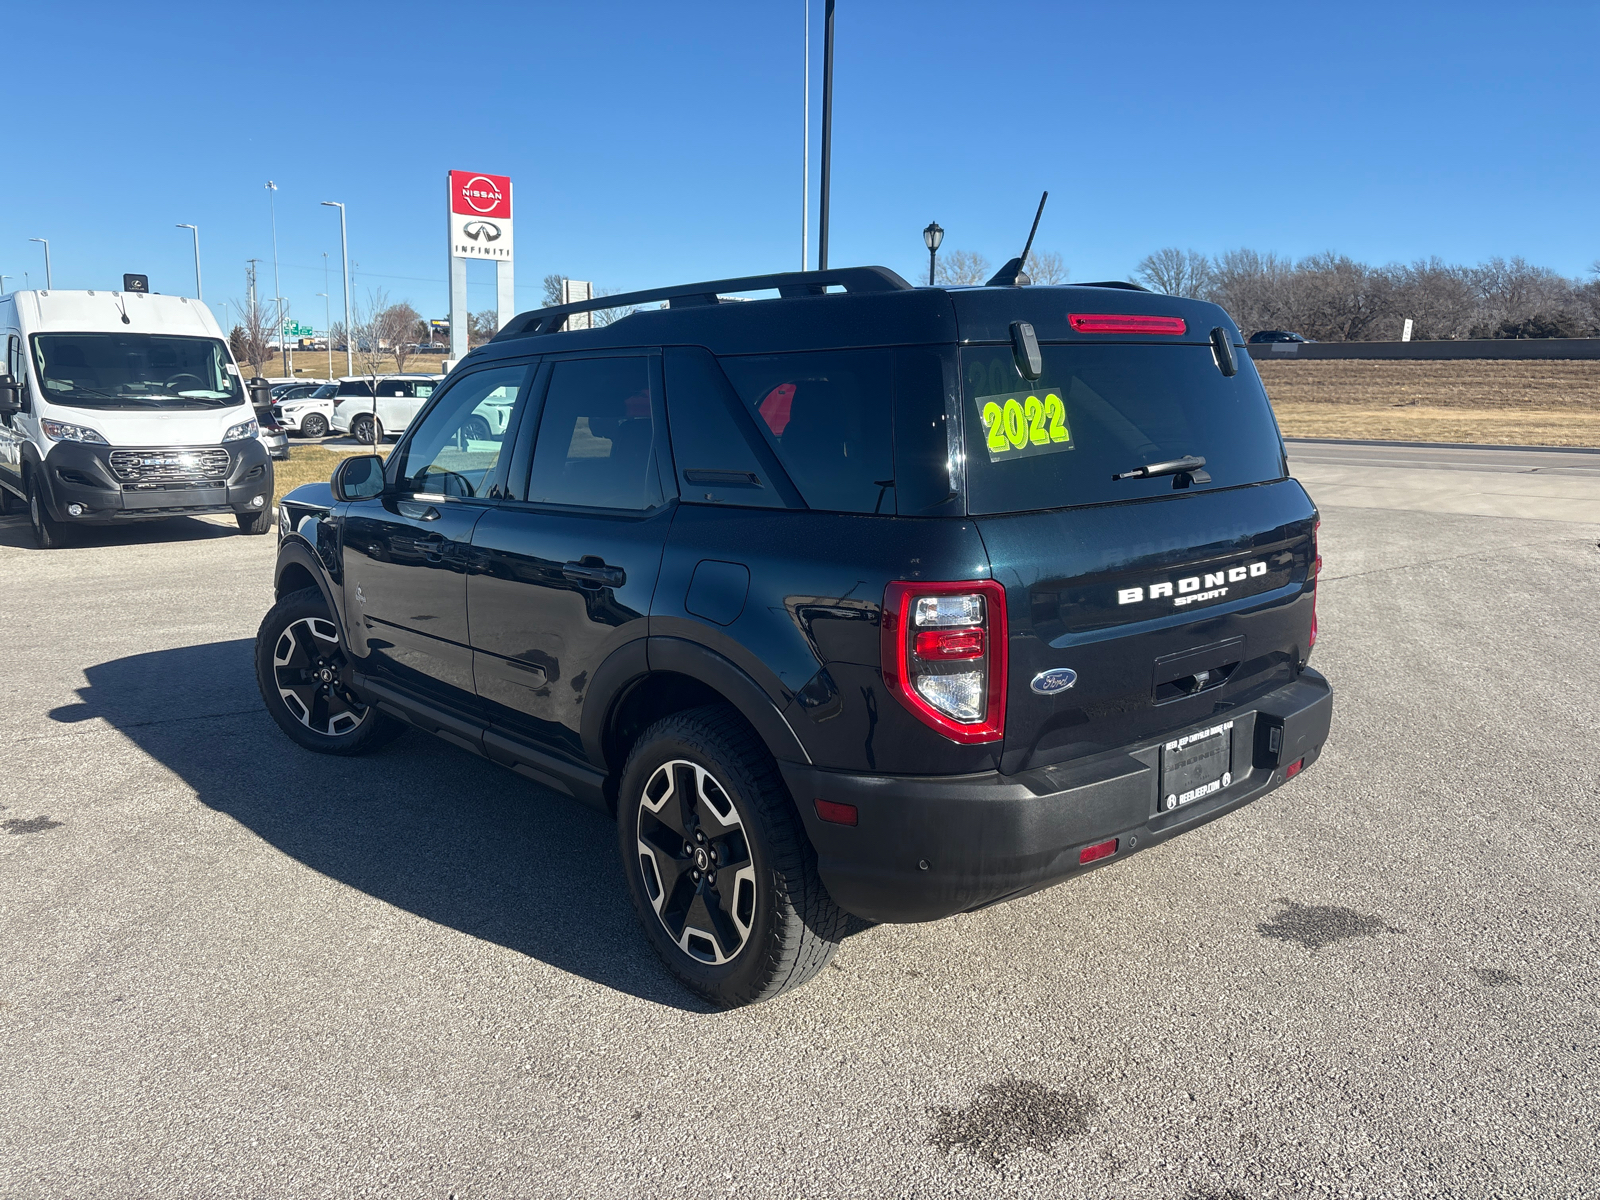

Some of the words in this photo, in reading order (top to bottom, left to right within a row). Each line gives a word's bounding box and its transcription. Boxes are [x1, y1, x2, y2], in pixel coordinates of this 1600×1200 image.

[462, 188, 502, 200] NISSAN
[455, 244, 510, 257] INFINITI
[983, 393, 1070, 453] 2022
[1117, 561, 1267, 605] BRONCO
[1173, 587, 1229, 607] SPORT
[1043, 674, 1069, 690] Ford
